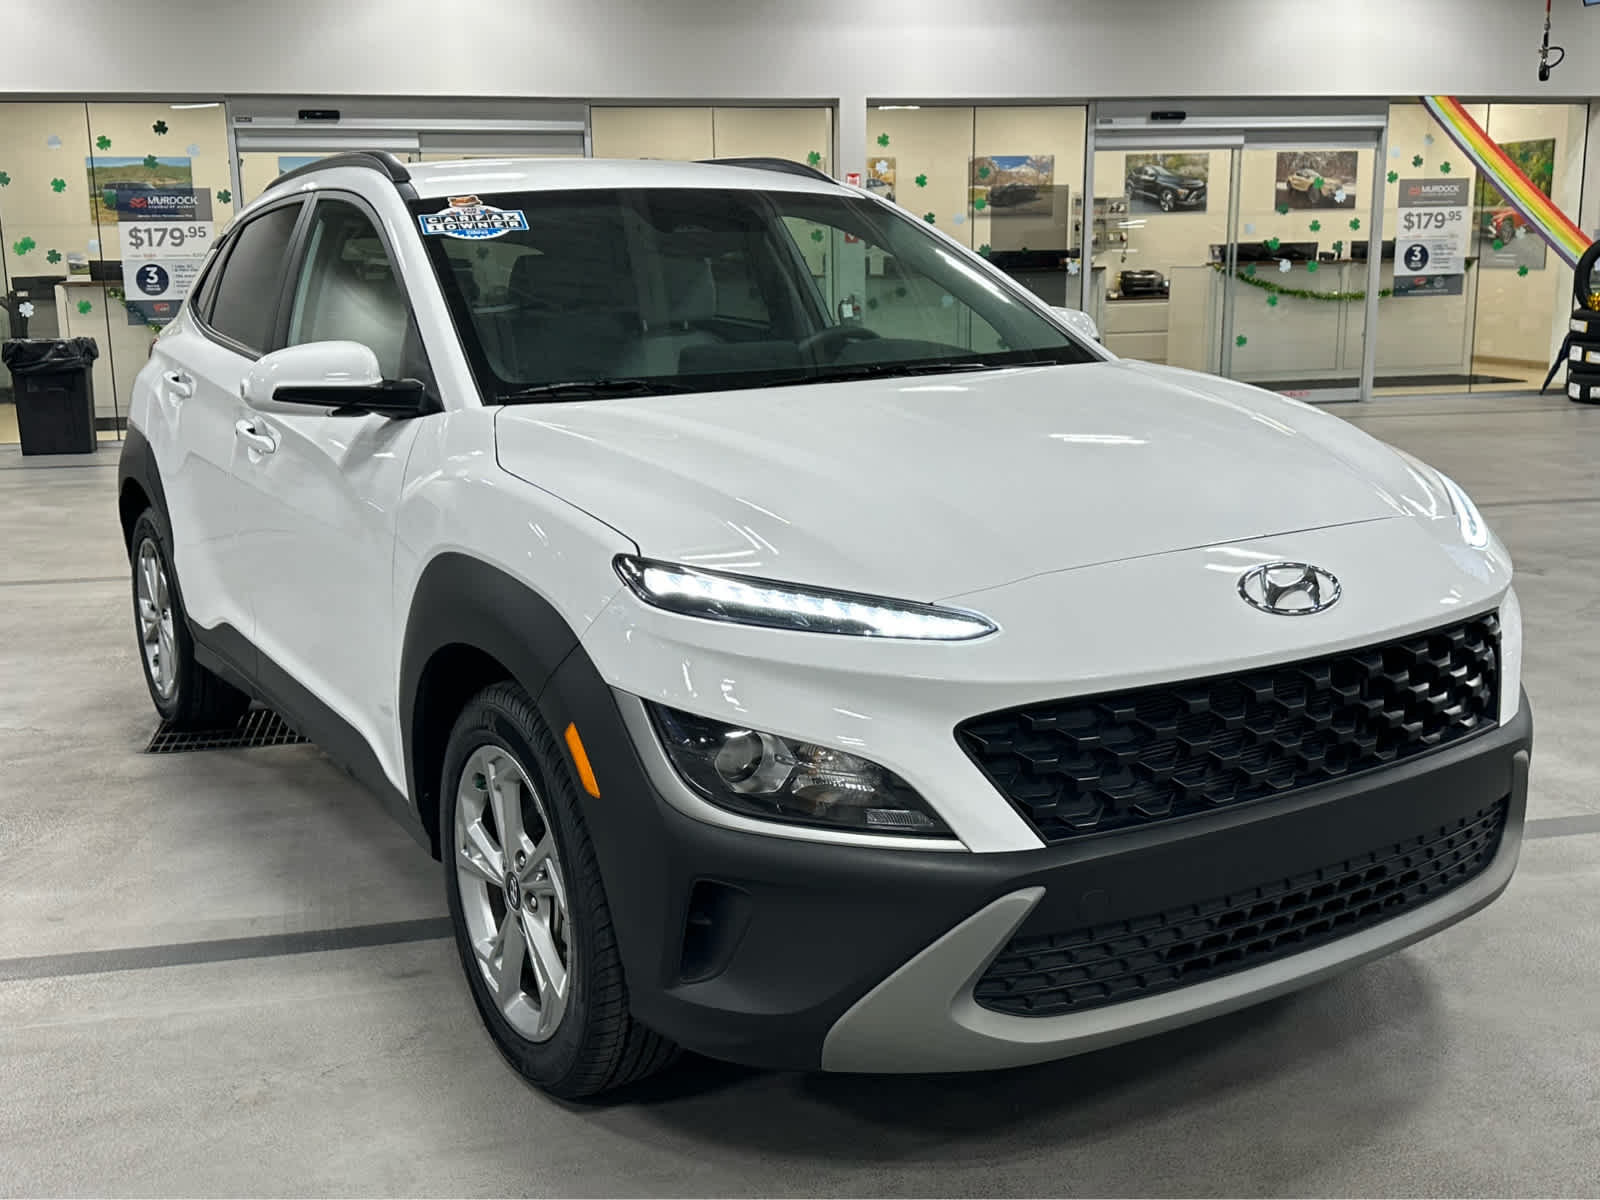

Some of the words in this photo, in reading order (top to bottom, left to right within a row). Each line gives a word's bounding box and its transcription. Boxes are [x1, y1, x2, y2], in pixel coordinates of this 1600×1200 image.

[147, 196, 198, 205] MURDOCK
[427, 213, 517, 224] CARFAX
[446, 220, 520, 230] OWNER
[1403, 210, 1462, 231] $179.95
[128, 226, 207, 249] $179.95
[1411, 246, 1422, 261] 3
[146, 266, 159, 284] 3
